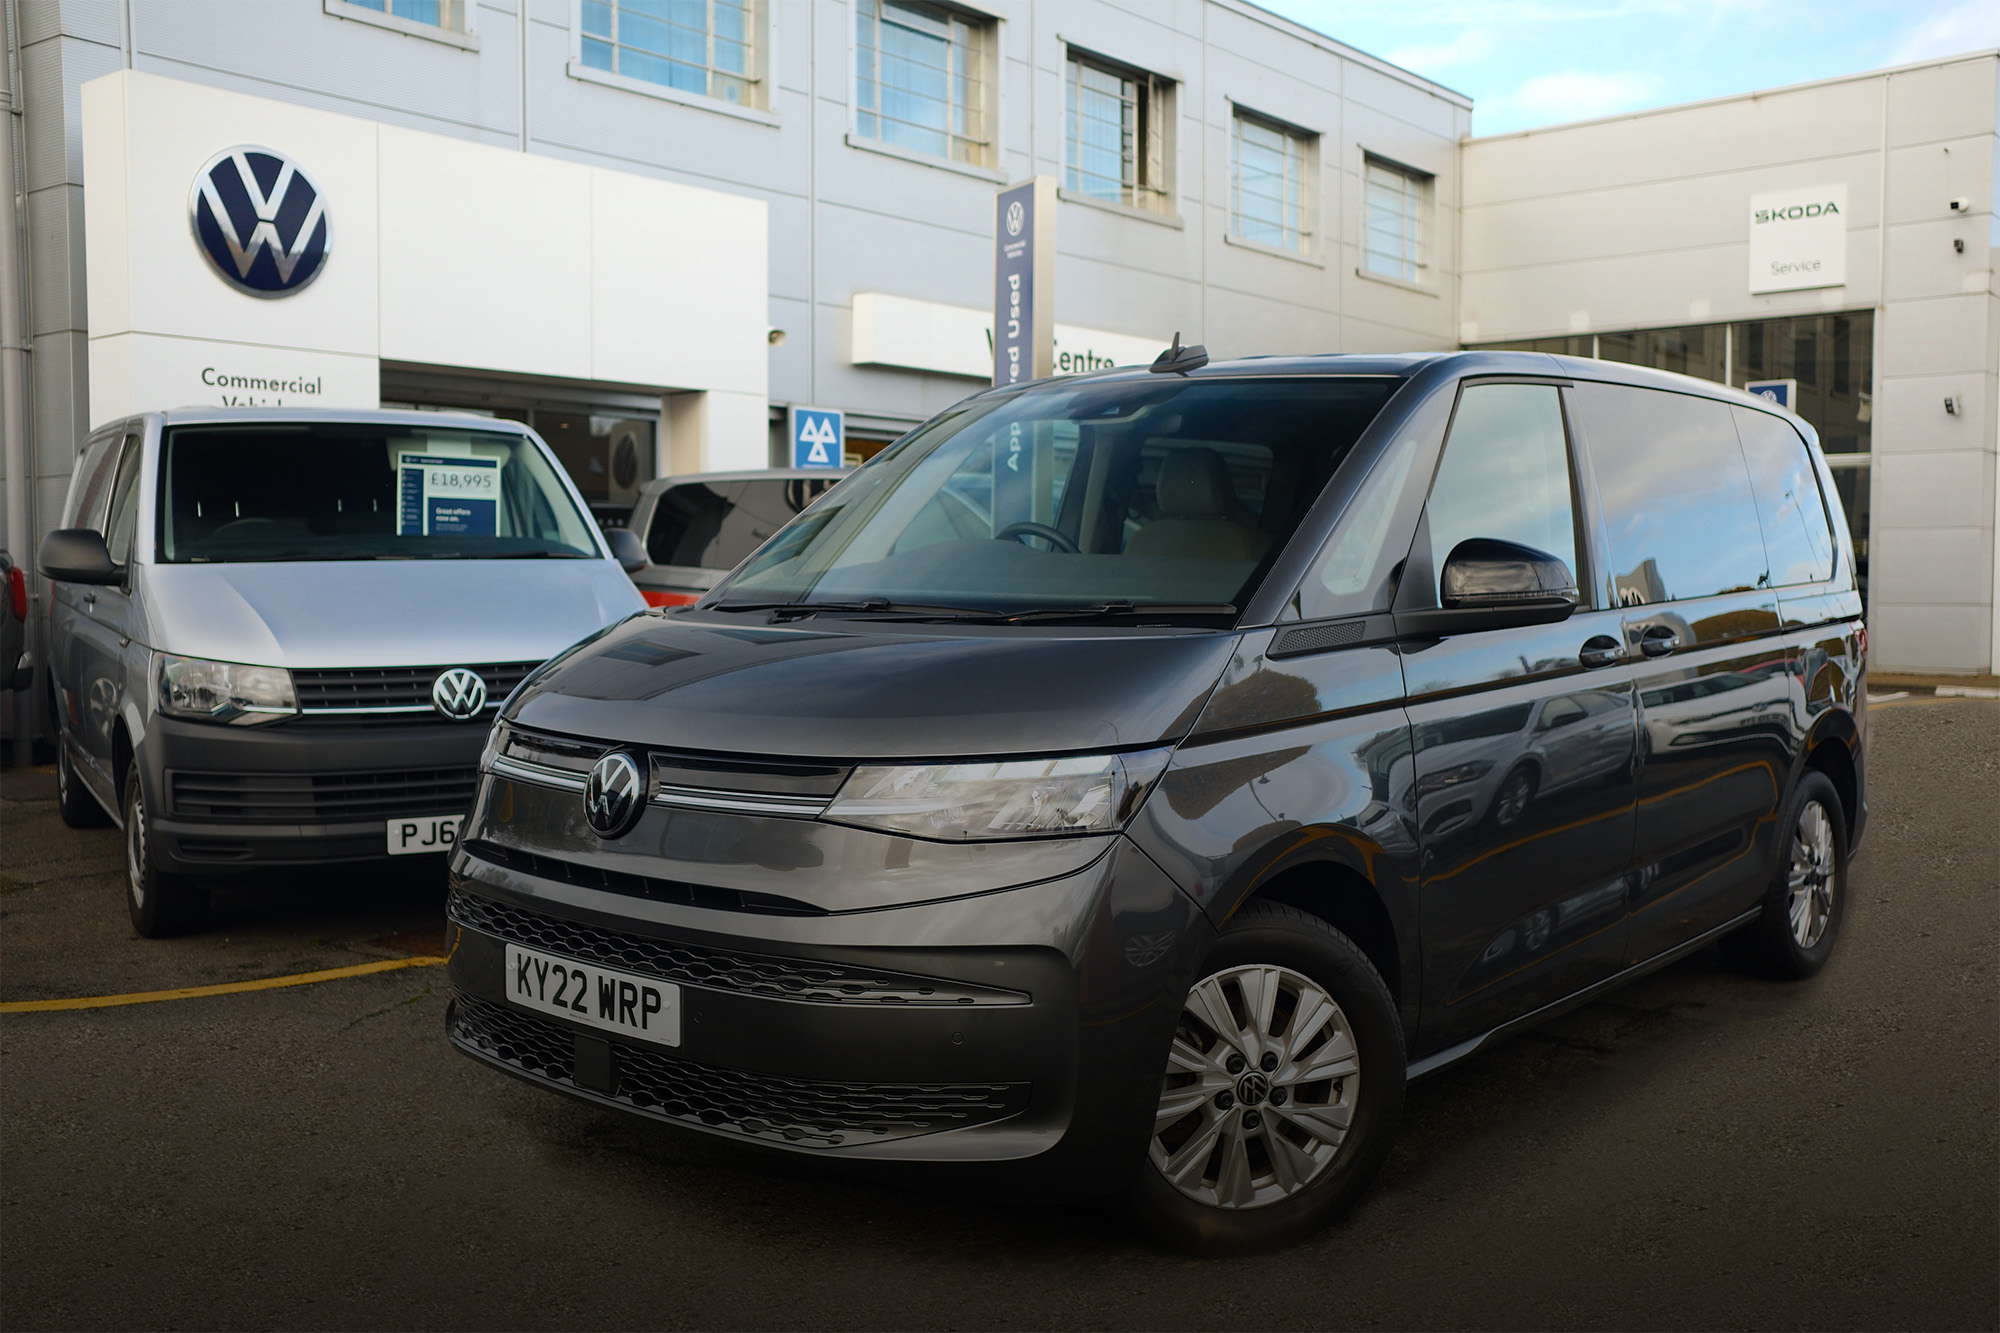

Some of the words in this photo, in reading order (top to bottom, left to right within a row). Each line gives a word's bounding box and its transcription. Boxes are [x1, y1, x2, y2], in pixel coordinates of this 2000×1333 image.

[1770, 259, 1822, 276] Service
[1007, 272, 1021, 339] Used
[201, 367, 321, 395] Commercial
[431, 471, 492, 489] £18,995
[401, 820, 465, 849] PJ6
[516, 952, 588, 1015] KY22
[597, 974, 662, 1031] WRP
